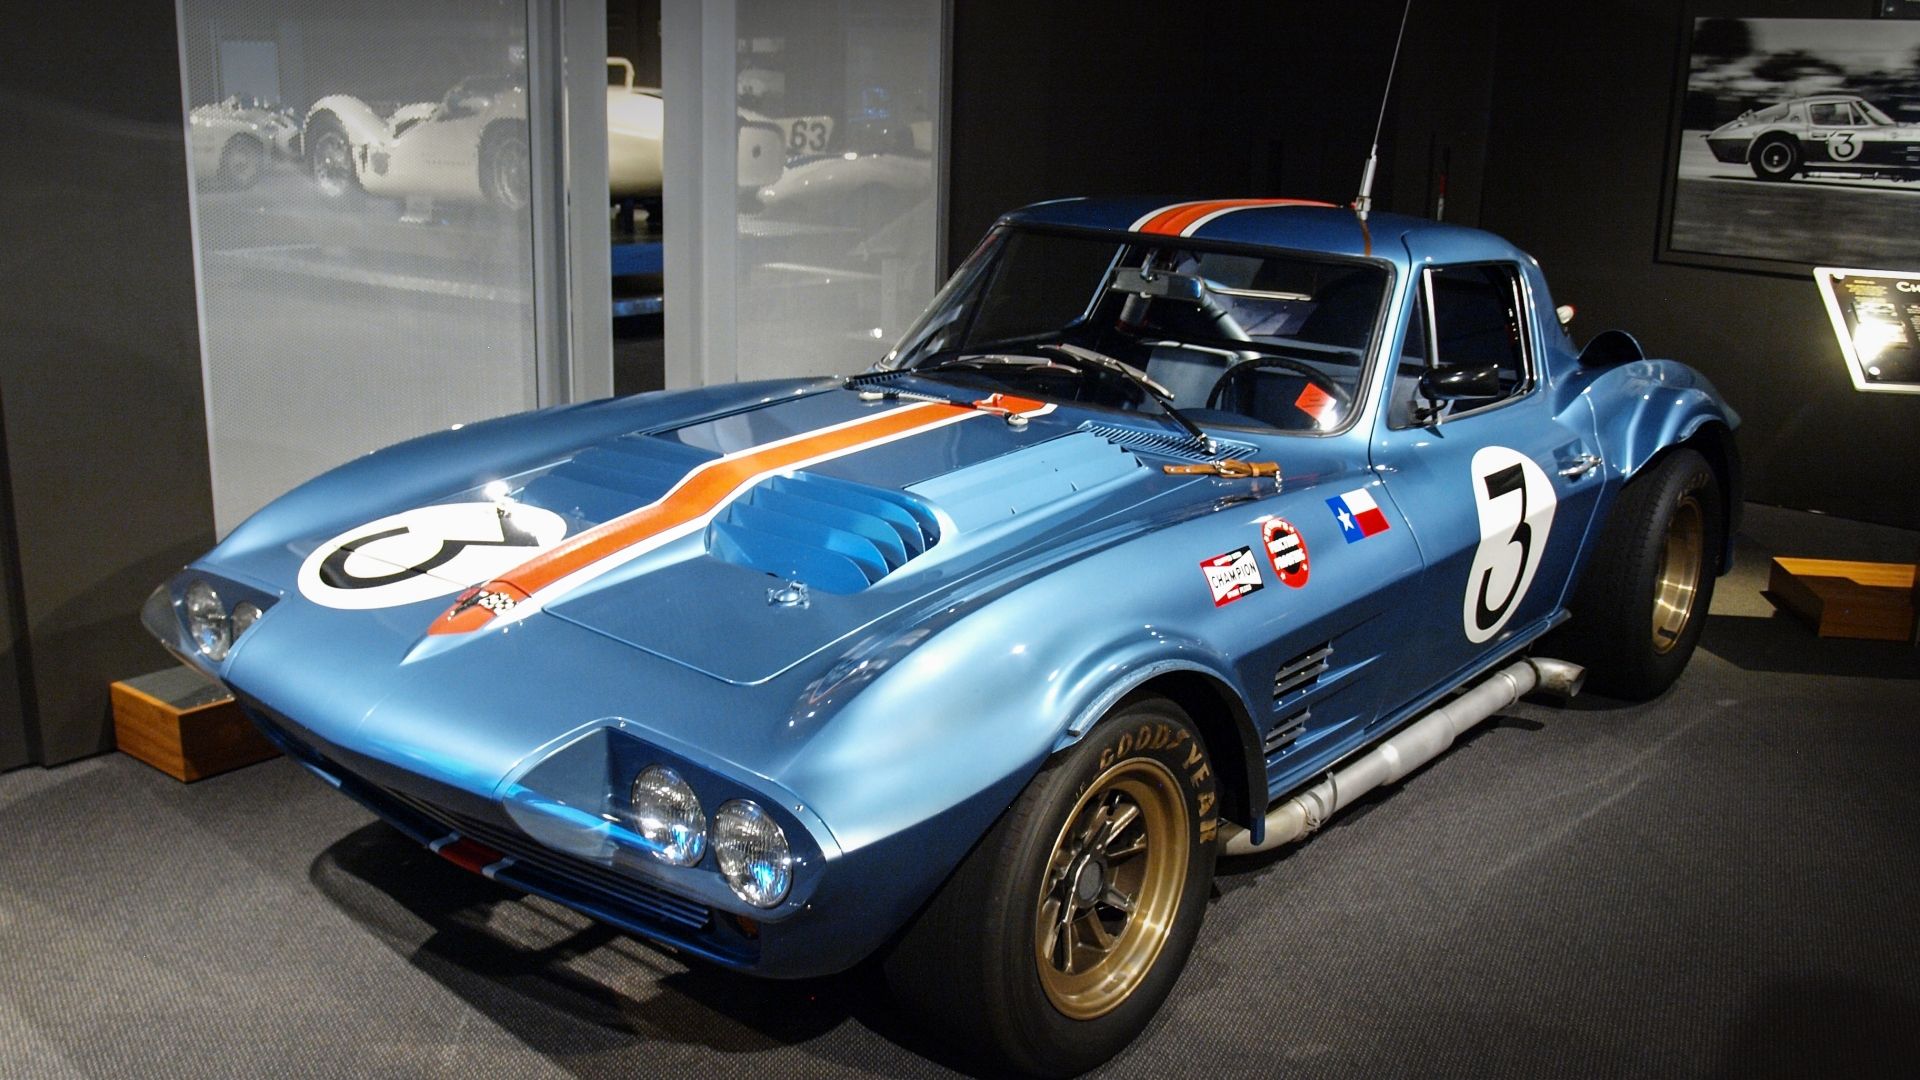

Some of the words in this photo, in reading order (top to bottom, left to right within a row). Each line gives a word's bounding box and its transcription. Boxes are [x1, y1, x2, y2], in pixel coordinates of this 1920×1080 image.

[790, 120, 826, 150] 63
[1834, 133, 1855, 158] 3
[319, 507, 539, 590] 3
[1475, 463, 1531, 631] 3
[1211, 562, 1257, 589] CHAMPION
